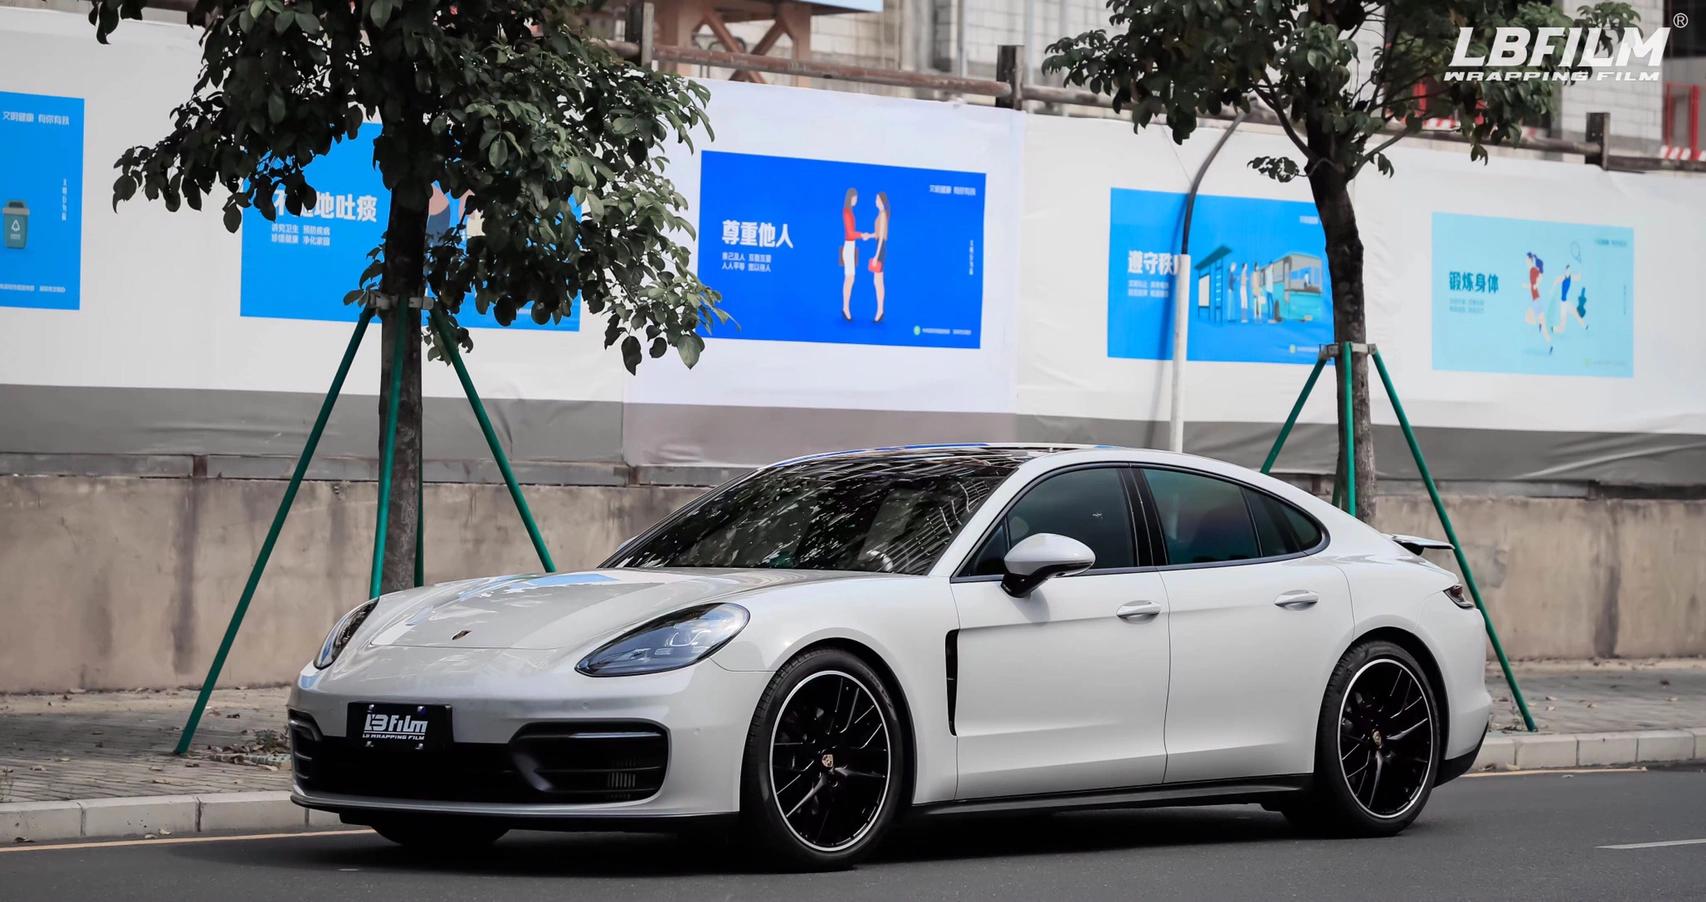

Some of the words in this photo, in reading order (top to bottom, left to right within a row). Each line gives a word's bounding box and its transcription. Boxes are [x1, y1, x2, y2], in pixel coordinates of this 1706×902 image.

[272, 189, 377, 222] 不地吐痰
[722, 220, 794, 248] 尊重他人
[1127, 250, 1179, 276] 遵守秩
[1449, 271, 1499, 293] 锻炼身体
